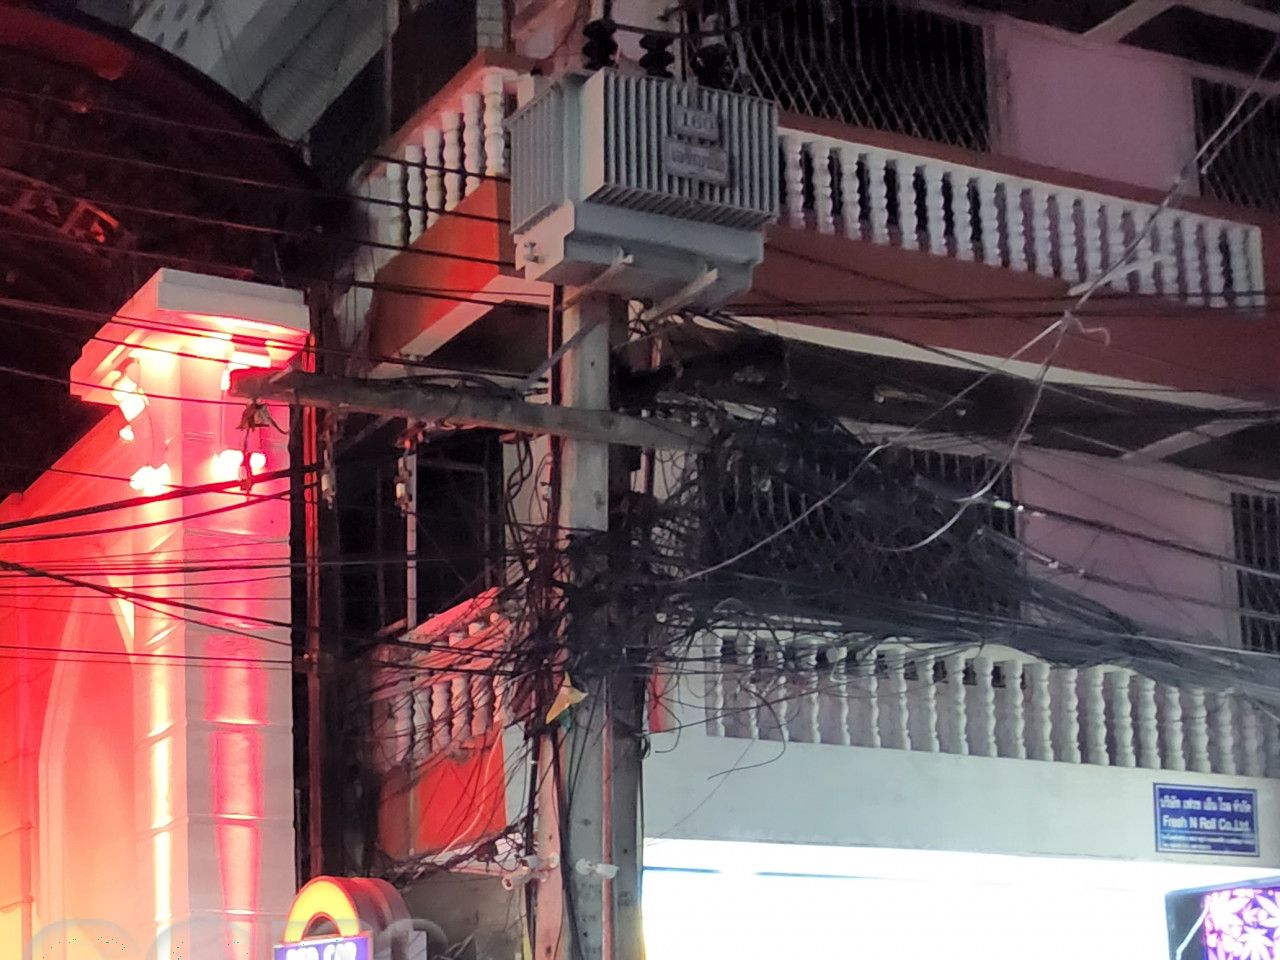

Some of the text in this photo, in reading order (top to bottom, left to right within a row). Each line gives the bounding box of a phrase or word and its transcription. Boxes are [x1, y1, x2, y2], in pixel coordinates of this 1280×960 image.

[1163, 814, 1188, 828] Fresh
[1189, 816, 1198, 829] N
[1200, 817, 1217, 830] Roll
